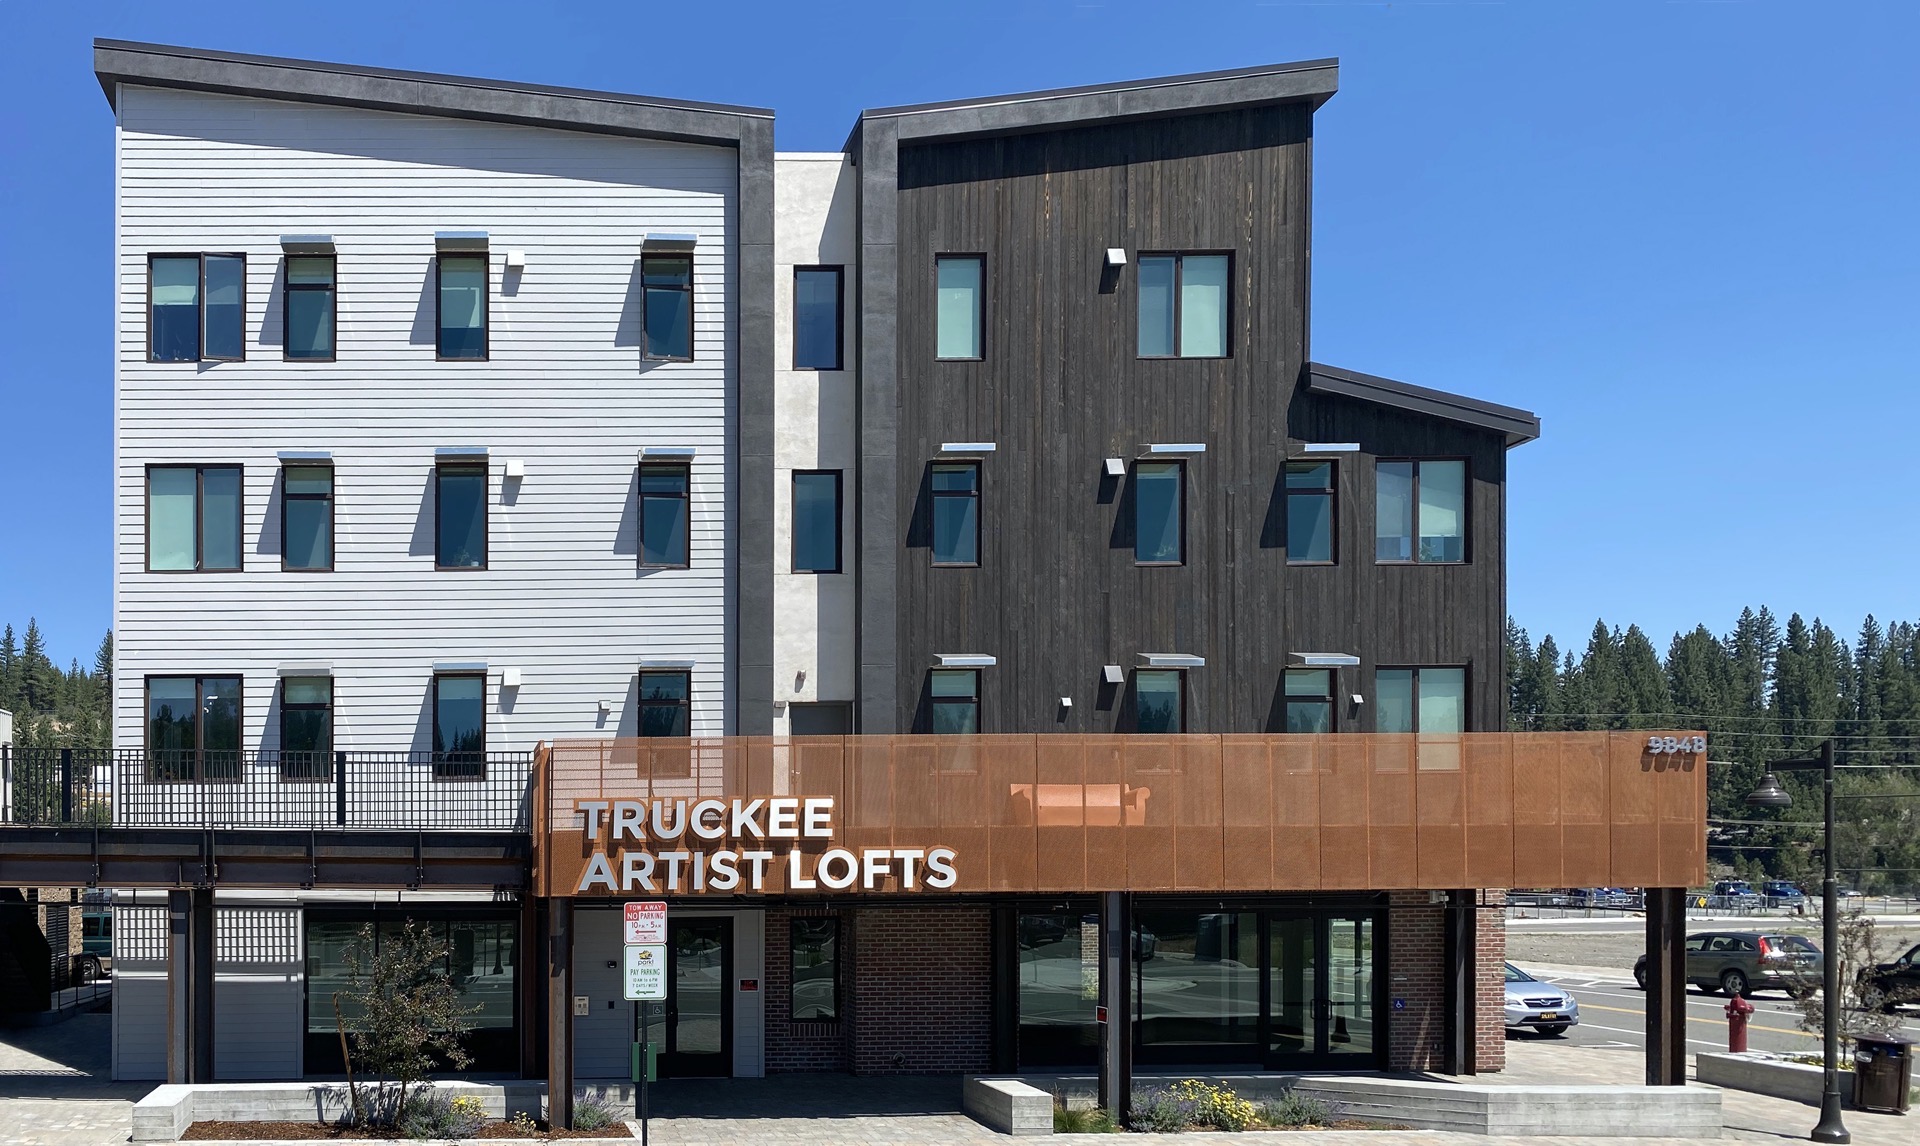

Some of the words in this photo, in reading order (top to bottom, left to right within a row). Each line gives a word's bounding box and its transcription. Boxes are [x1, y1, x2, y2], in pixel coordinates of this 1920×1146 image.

[1648, 736, 1707, 754] 9848
[578, 798, 834, 840] TRUCKEE
[578, 850, 773, 891] ARTIST
[789, 848, 957, 890] LOFTS
[627, 912, 639, 920] NO
[640, 911, 664, 920] PARKING
[630, 968, 639, 976] PAY
[640, 968, 660, 976] PARKING
